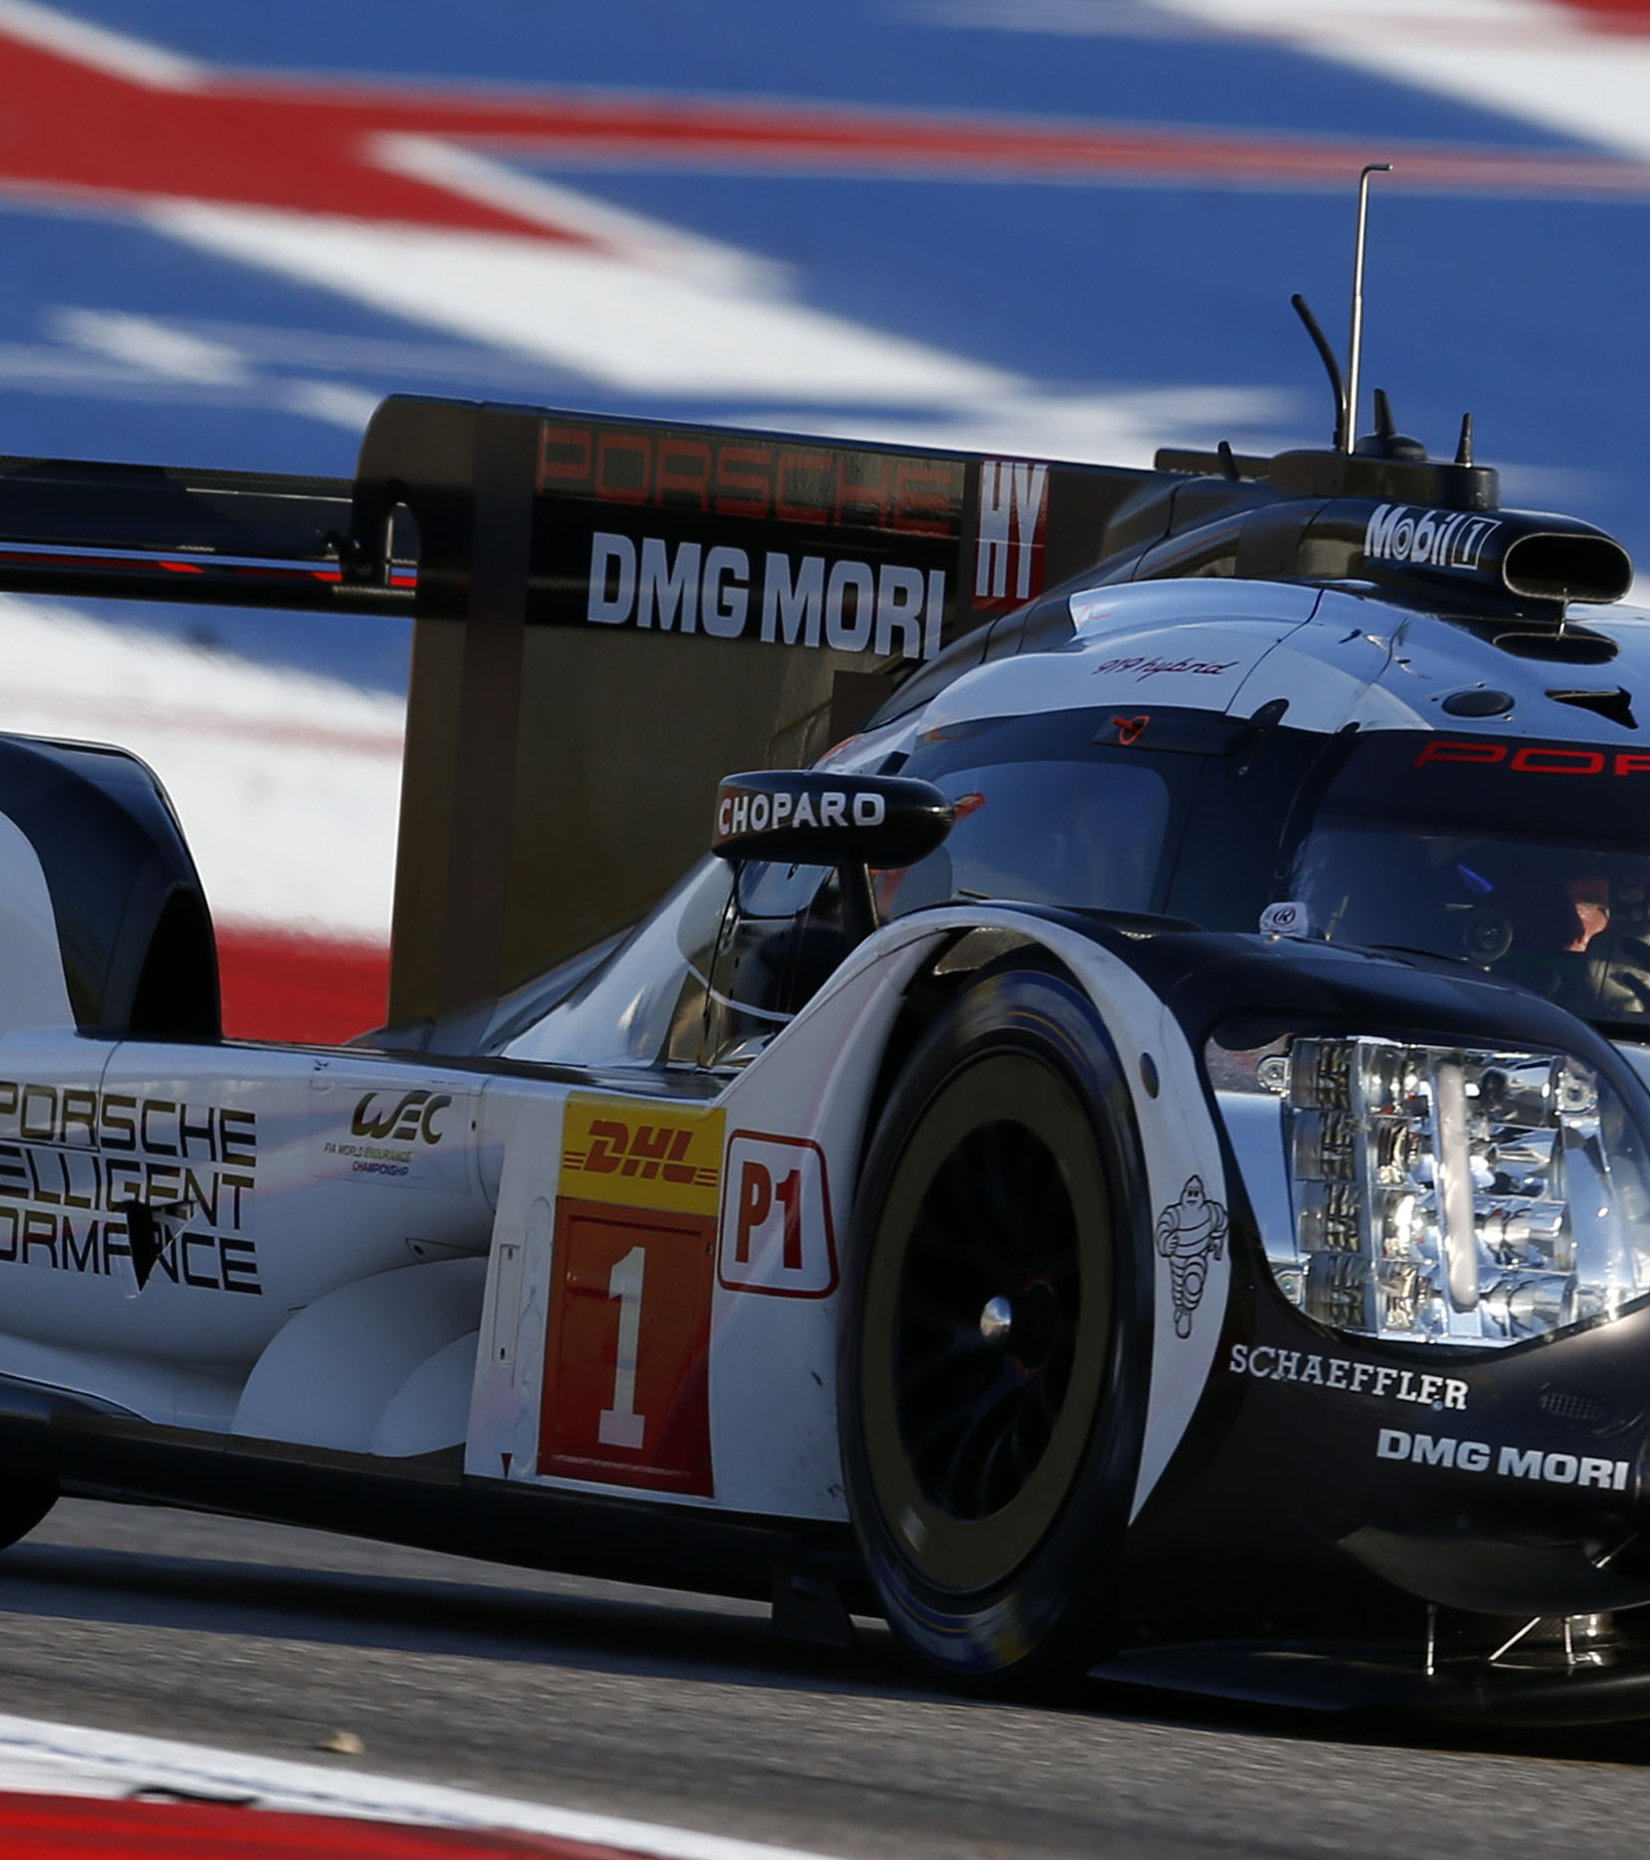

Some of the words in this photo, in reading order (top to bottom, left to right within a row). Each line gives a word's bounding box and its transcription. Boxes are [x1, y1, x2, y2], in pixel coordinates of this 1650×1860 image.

[536, 426, 953, 536] PORSCHE
[976, 460, 1048, 599] HY
[1363, 503, 1466, 567] Mobil
[587, 531, 750, 639] DMG
[759, 551, 946, 661] MORI
[718, 792, 886, 836] CHOPARD
[351, 1089, 453, 1146] WEC
[583, 1119, 698, 1185] DHL
[734, 1160, 804, 1271] P1
[597, 1245, 647, 1451] 1
[1228, 1343, 1470, 1411] SCHAEFFLER
[1375, 1428, 1490, 1472] DMG
[1497, 1446, 1631, 1491] MORI
